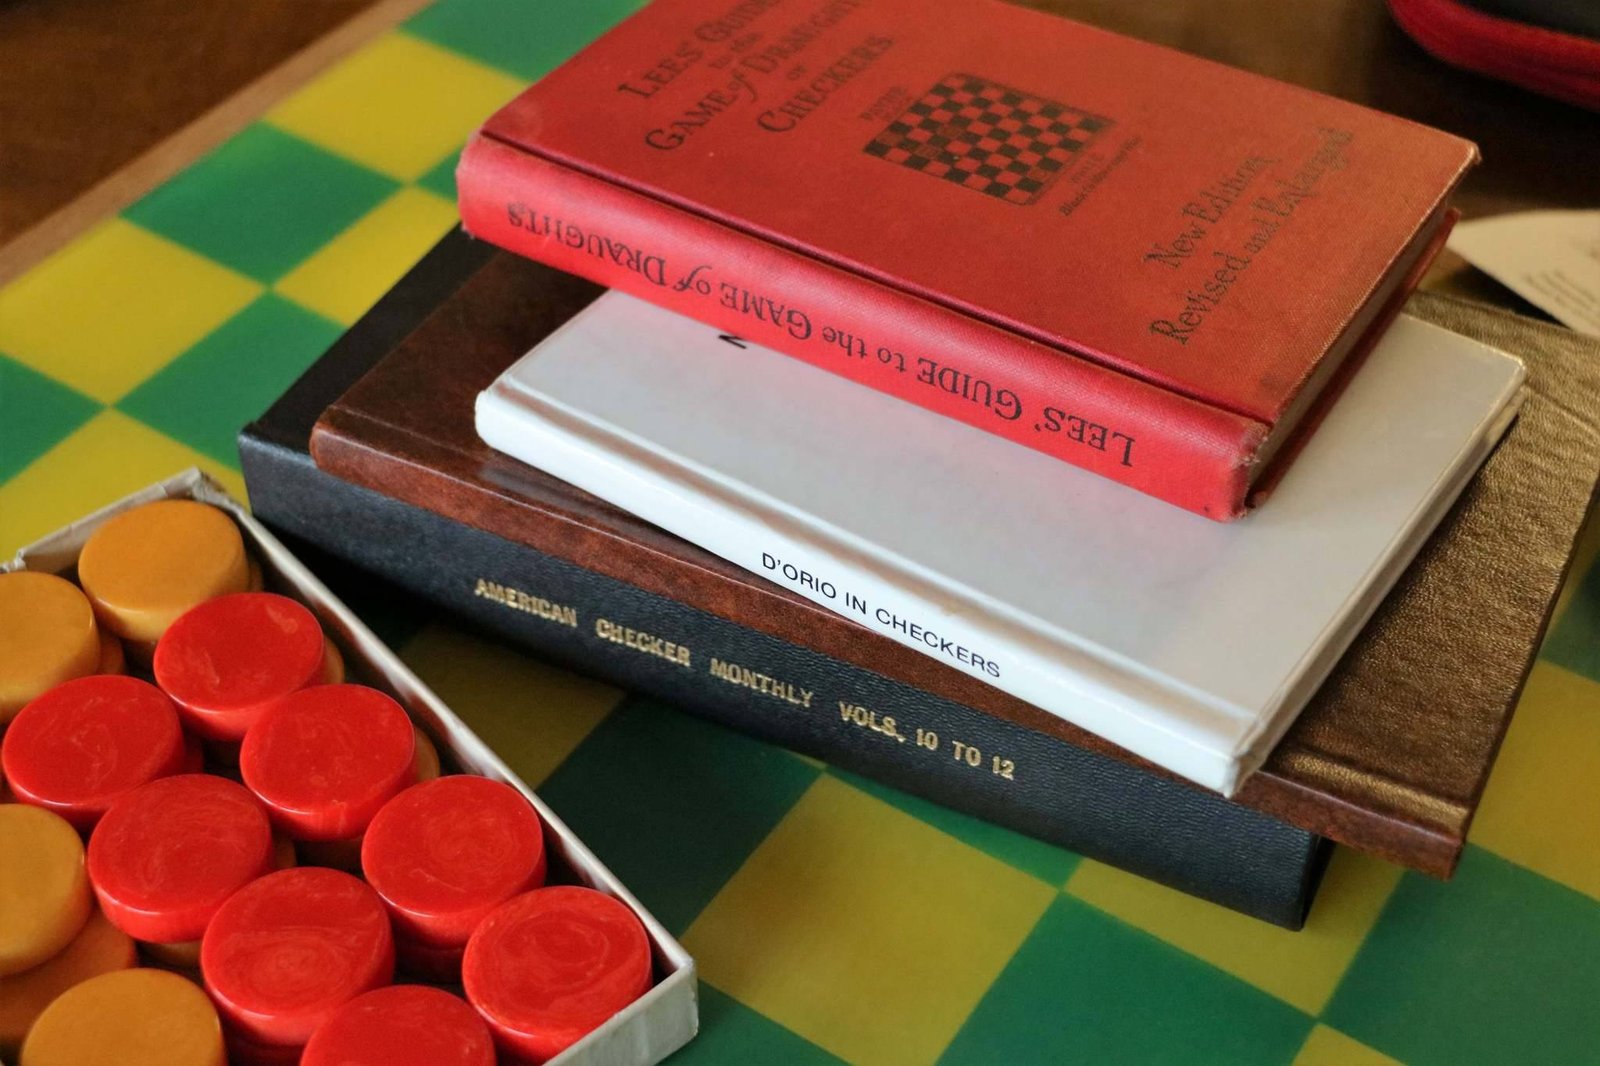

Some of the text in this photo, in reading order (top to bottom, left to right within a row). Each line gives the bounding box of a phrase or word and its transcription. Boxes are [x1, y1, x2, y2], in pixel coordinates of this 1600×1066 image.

[695, 0, 781, 42] GUID
[645, 89, 737, 150] GAME
[728, 69, 757, 101] of
[757, 36, 893, 132] CHECKERS
[1143, 221, 1206, 270] New
[1149, 251, 1251, 345] Revised
[1244, 215, 1282, 254] and
[506, 201, 1136, 467] LEES' GUIDE to the GAME of DRAUGHTS
[762, 552, 1000, 678] D'ORIO IN CHECKERS
[474, 578, 577, 628] AMERICAN
[595, 618, 691, 667] CHECKER
[710, 657, 813, 708] MONTHLY
[916, 728, 938, 751] 10
[952, 740, 982, 767] TO
[992, 756, 1015, 780] 12
